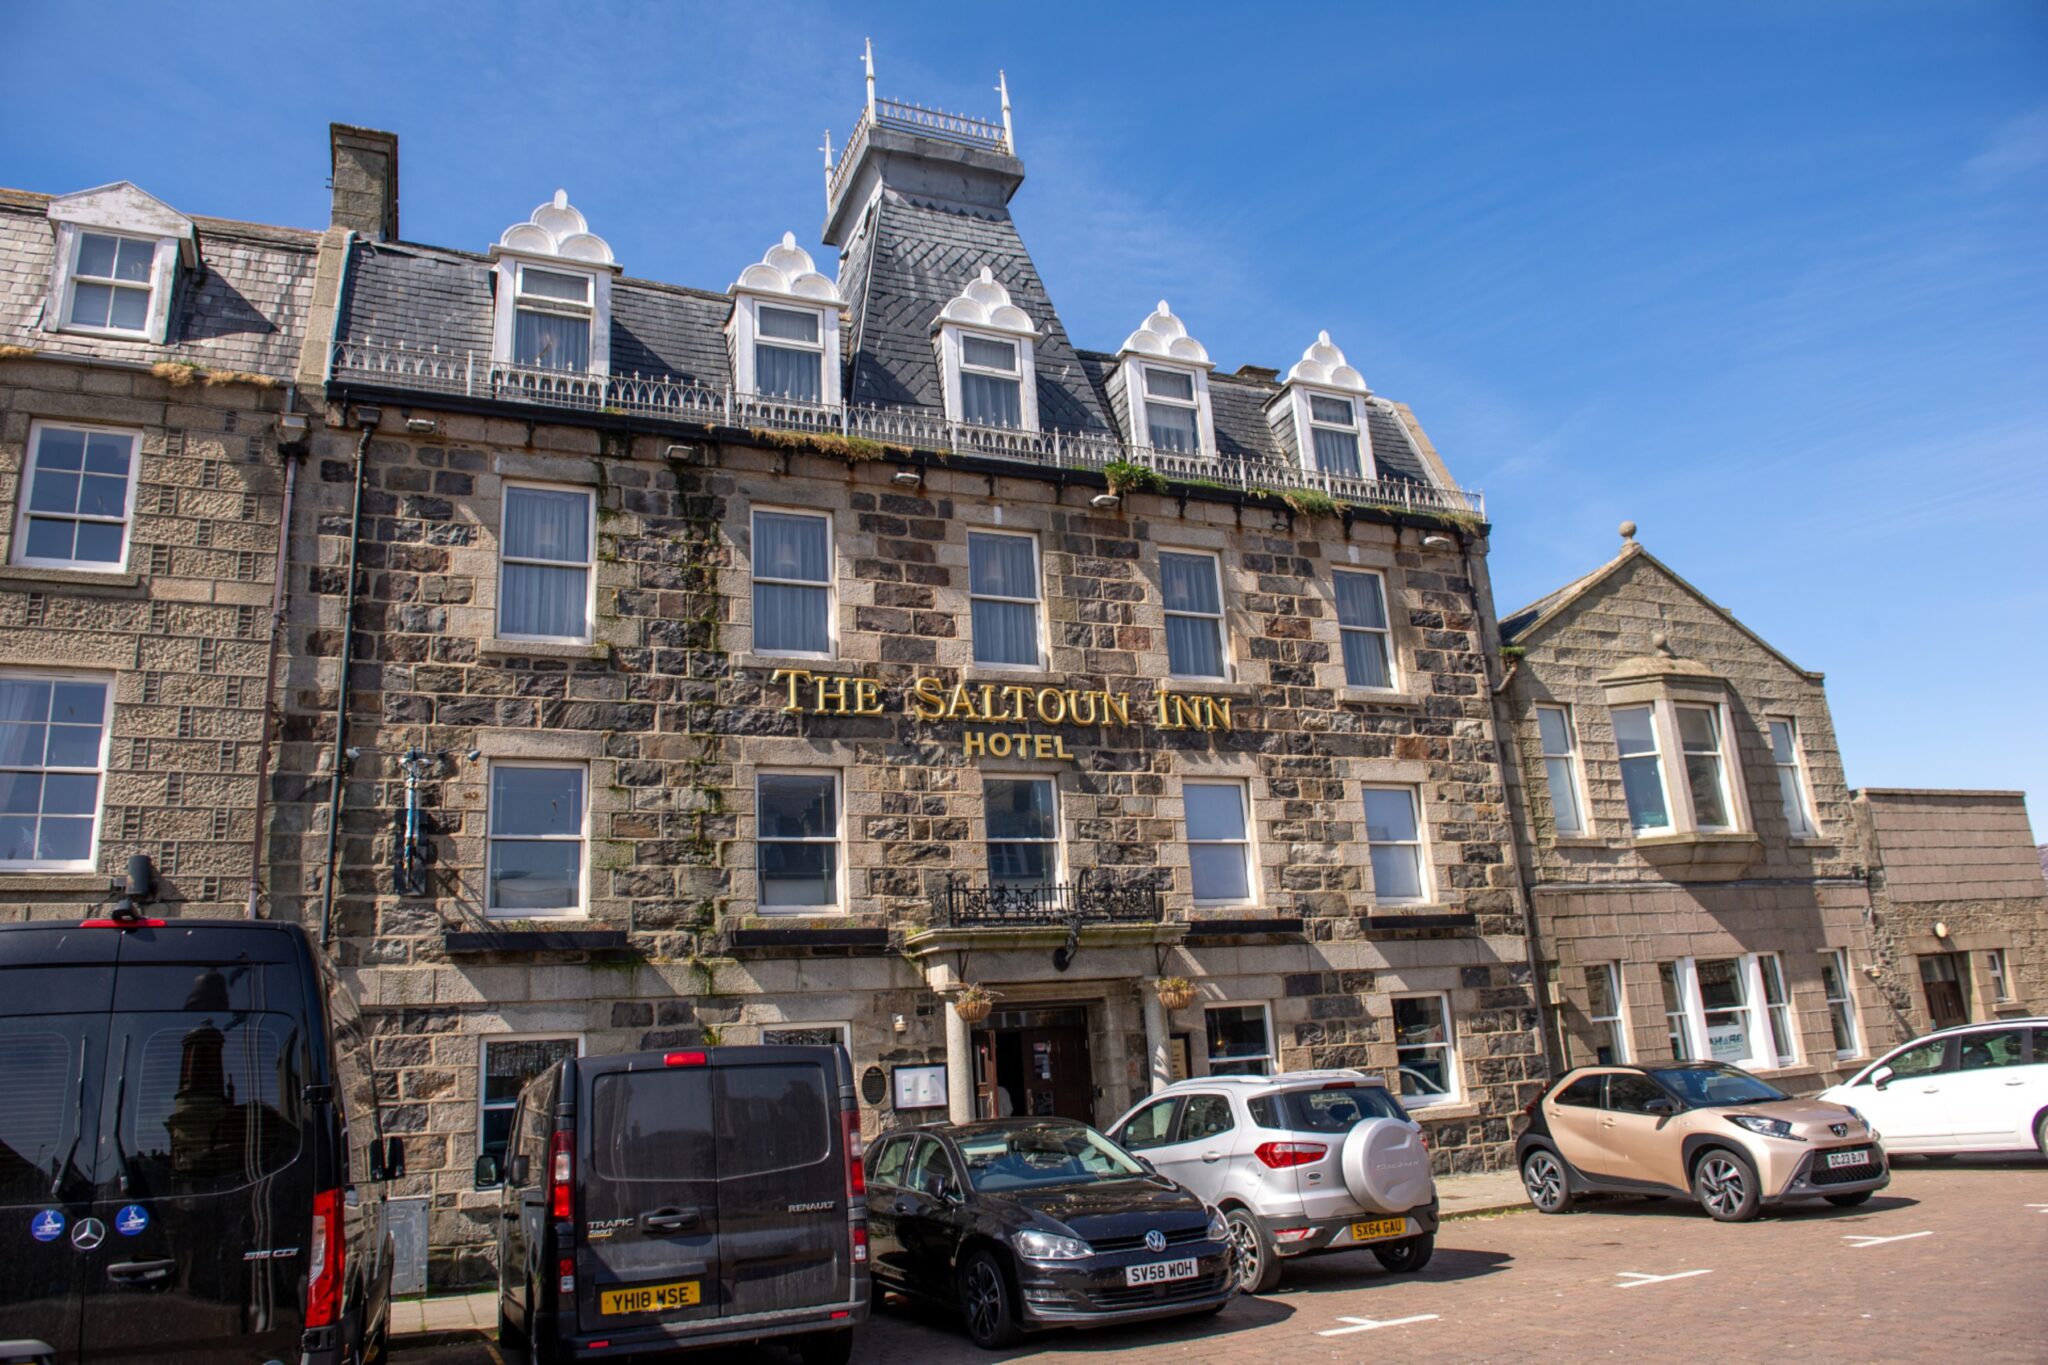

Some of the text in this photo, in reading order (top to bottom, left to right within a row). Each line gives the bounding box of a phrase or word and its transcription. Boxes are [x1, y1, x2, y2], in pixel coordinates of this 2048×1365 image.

[771, 668, 1233, 733] THE SALTOUN INN
[964, 731, 1074, 761] HOTEL
[788, 1200, 835, 1213] RENAULT
[587, 1217, 634, 1229] TRAFIC
[1355, 1219, 1401, 1237] SX64 GAU
[1131, 1261, 1193, 1282] SV58 WOH
[612, 1286, 690, 1312] YH18 WSE
